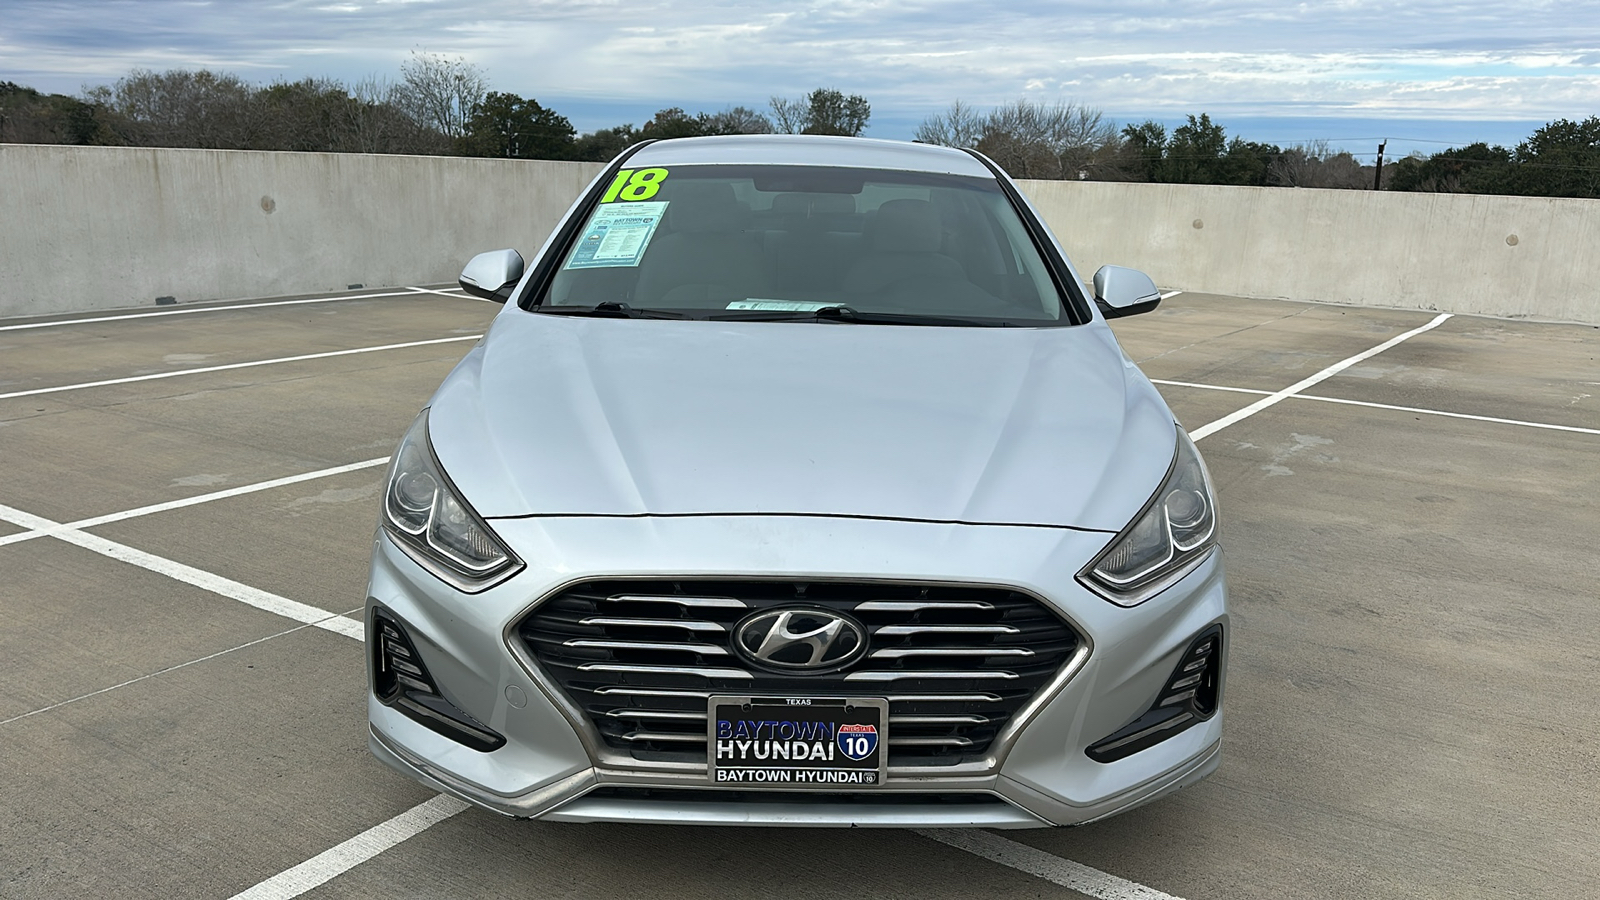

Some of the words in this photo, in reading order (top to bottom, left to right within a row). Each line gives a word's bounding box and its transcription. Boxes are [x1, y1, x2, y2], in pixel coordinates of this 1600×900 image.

[601, 168, 669, 203] 18
[717, 720, 835, 741] BAYTOWN
[845, 738, 869, 756] 10
[717, 770, 790, 782] BAYTOWN
[795, 771, 862, 783] HYUNDAI
